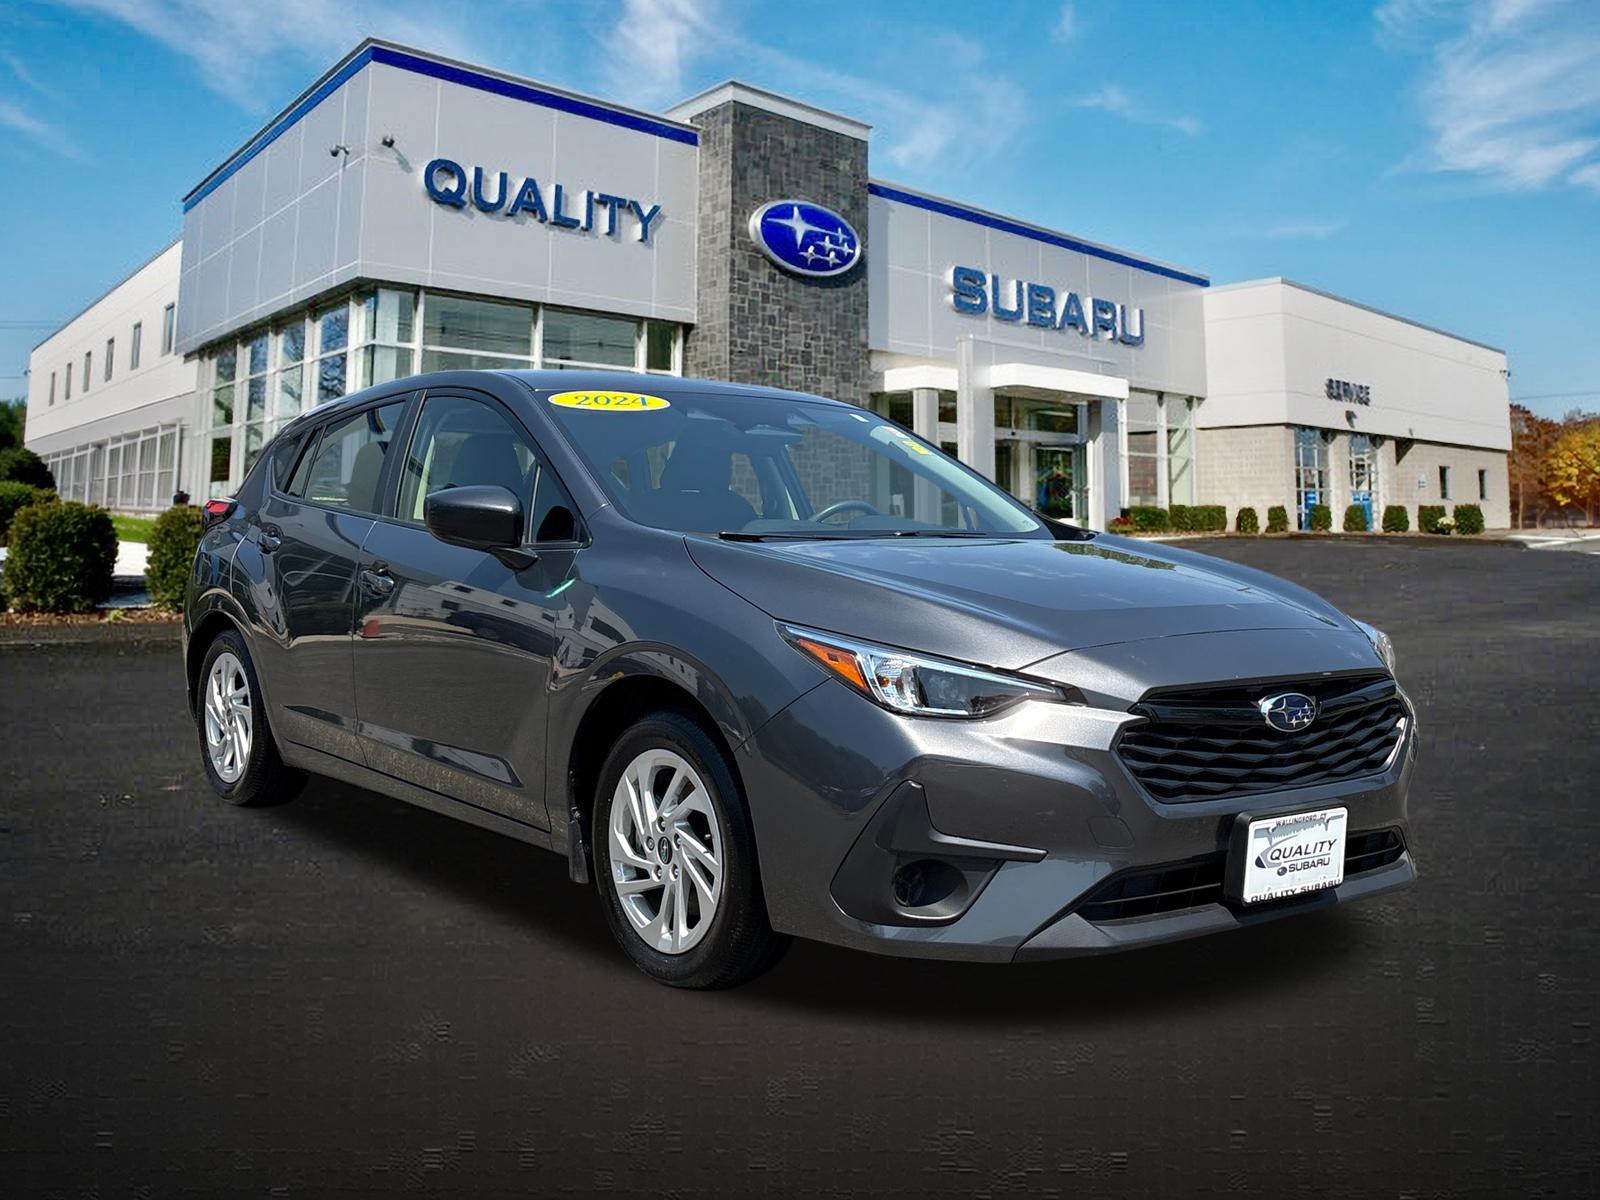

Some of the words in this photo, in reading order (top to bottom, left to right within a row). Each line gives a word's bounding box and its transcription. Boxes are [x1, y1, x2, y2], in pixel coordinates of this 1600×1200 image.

[424, 157, 661, 243] QUALITY
[951, 265, 1145, 347] SUBARU
[574, 394, 648, 407] 2024
[1270, 839, 1337, 861] QUALITY
[1288, 857, 1331, 874] SUBARU
[1251, 888, 1297, 902] QUALITY
[1301, 880, 1341, 893] SUBARU
